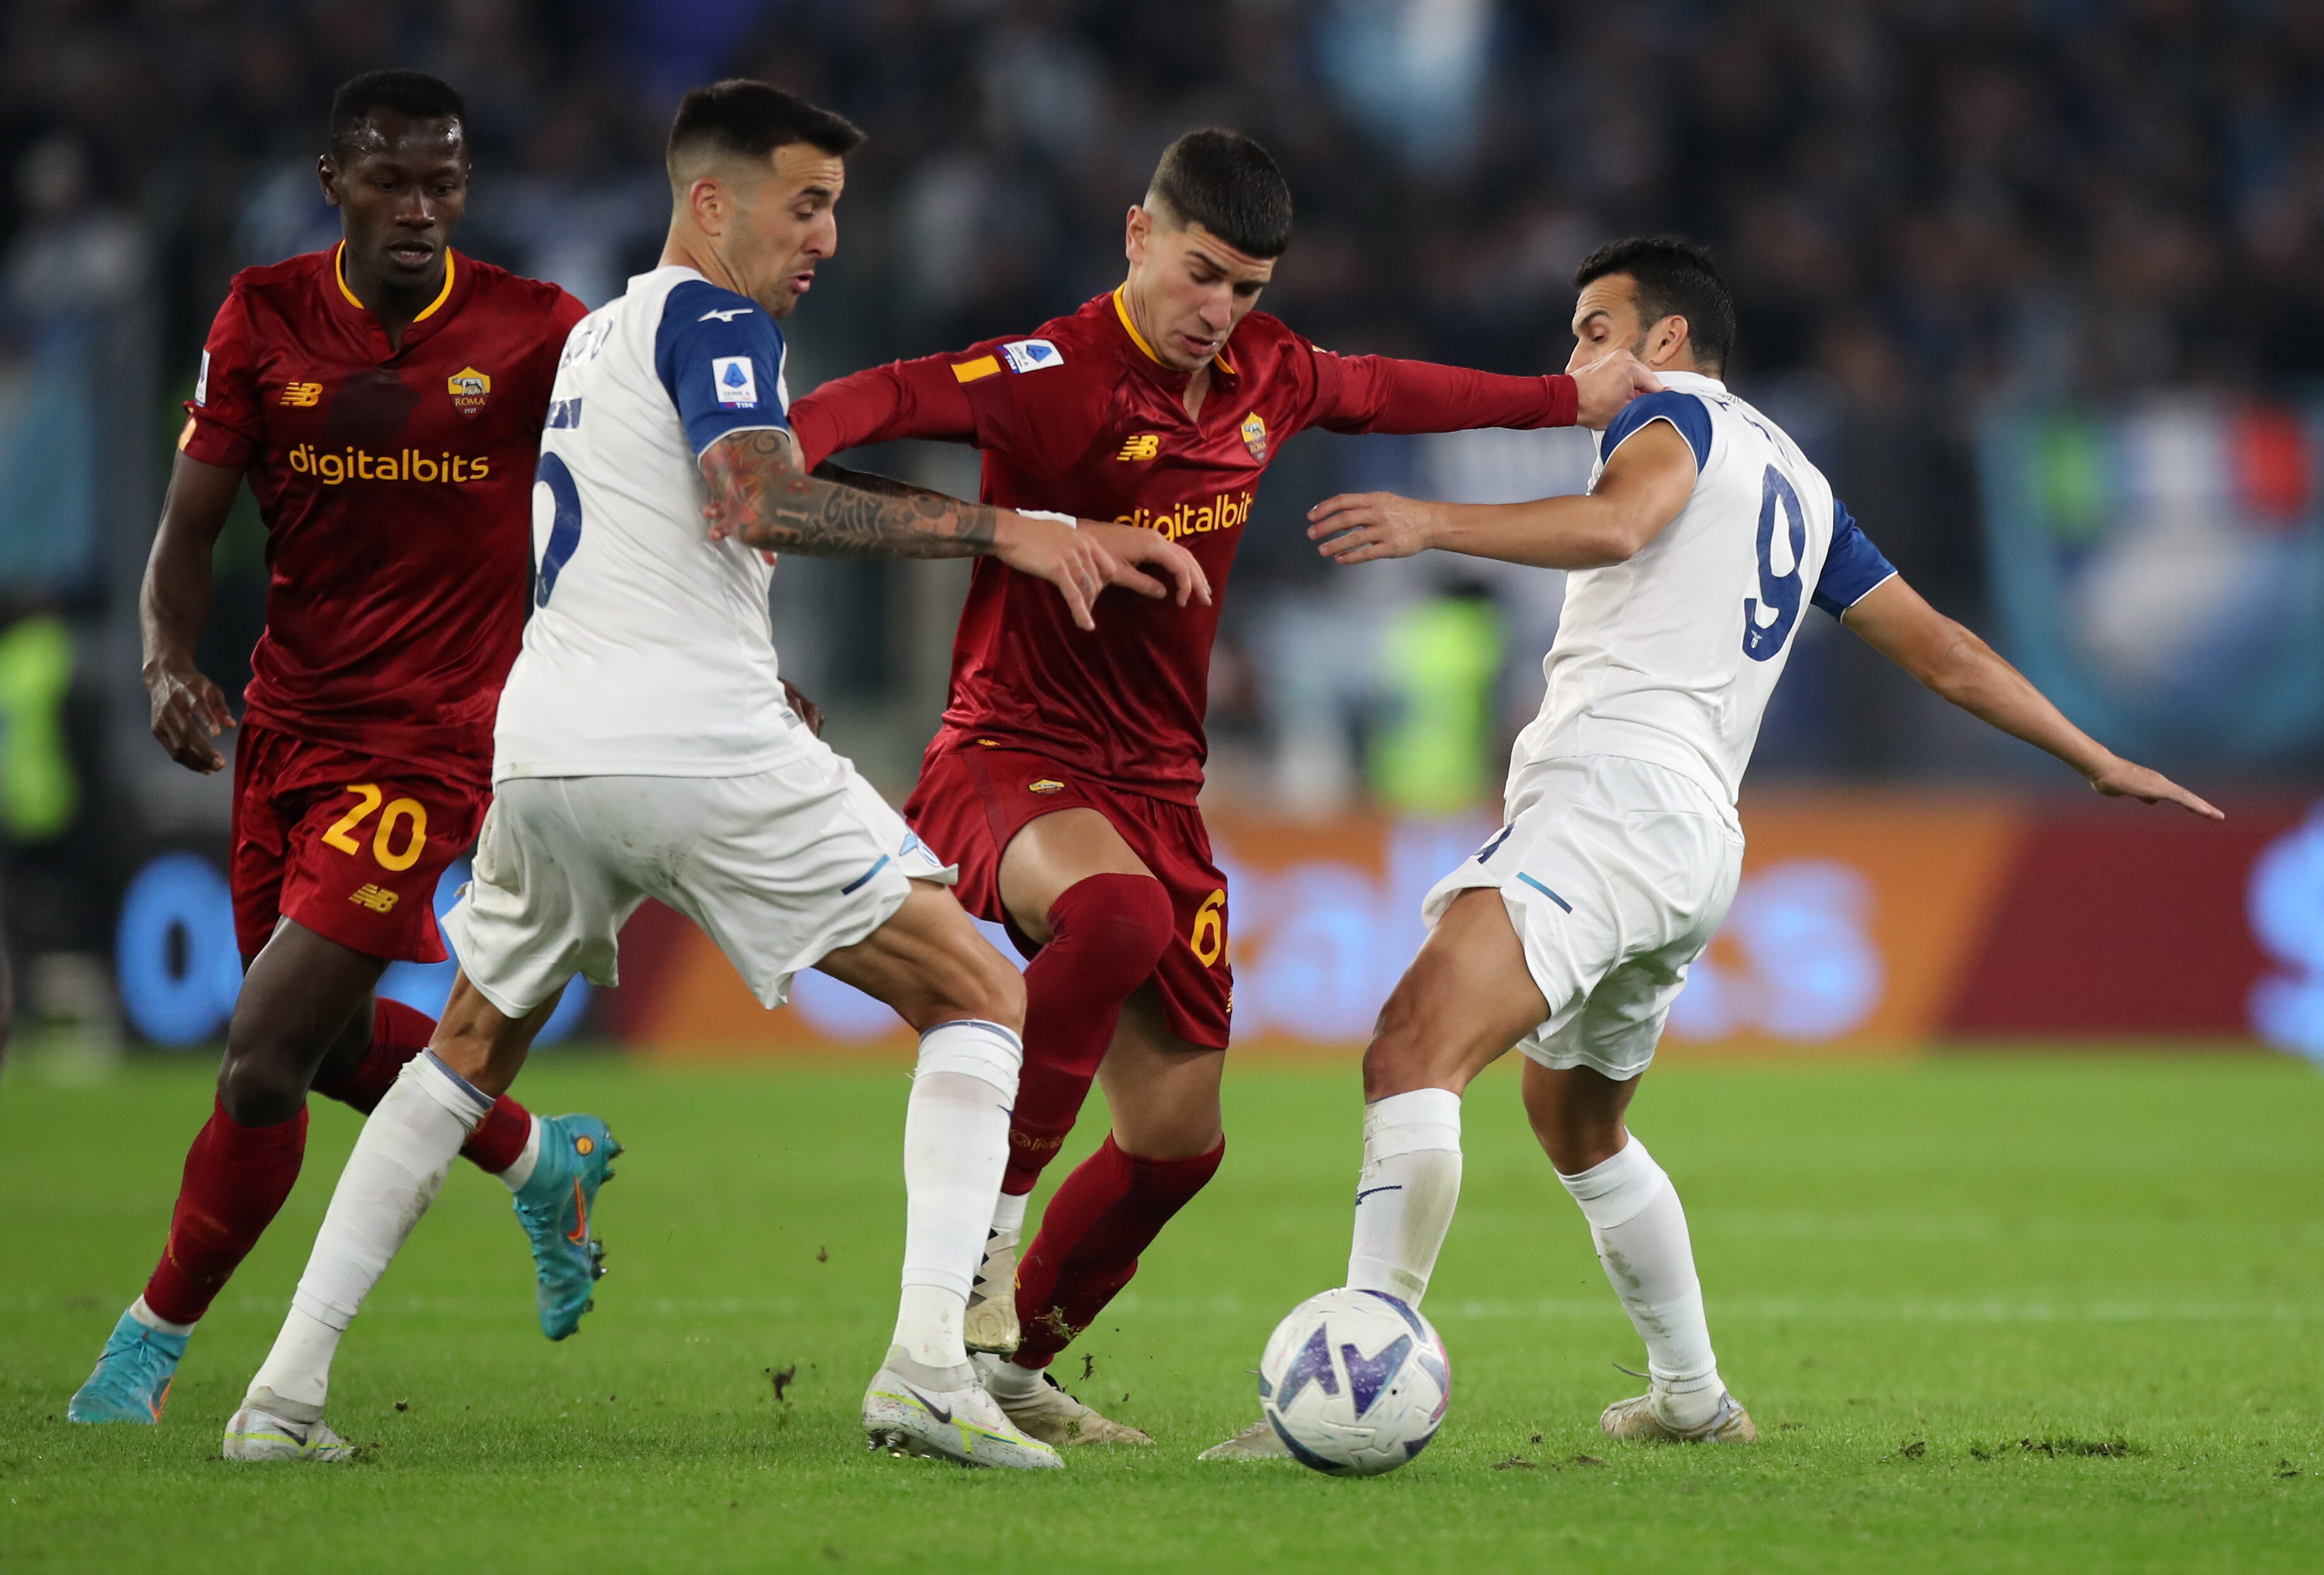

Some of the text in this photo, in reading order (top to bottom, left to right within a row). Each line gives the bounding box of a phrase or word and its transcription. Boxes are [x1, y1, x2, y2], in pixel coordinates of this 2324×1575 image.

[455, 397, 485, 406] ROMA
[289, 443, 490, 486] digitalbits
[1742, 463, 1806, 662] 9
[321, 783, 428, 871] 20
